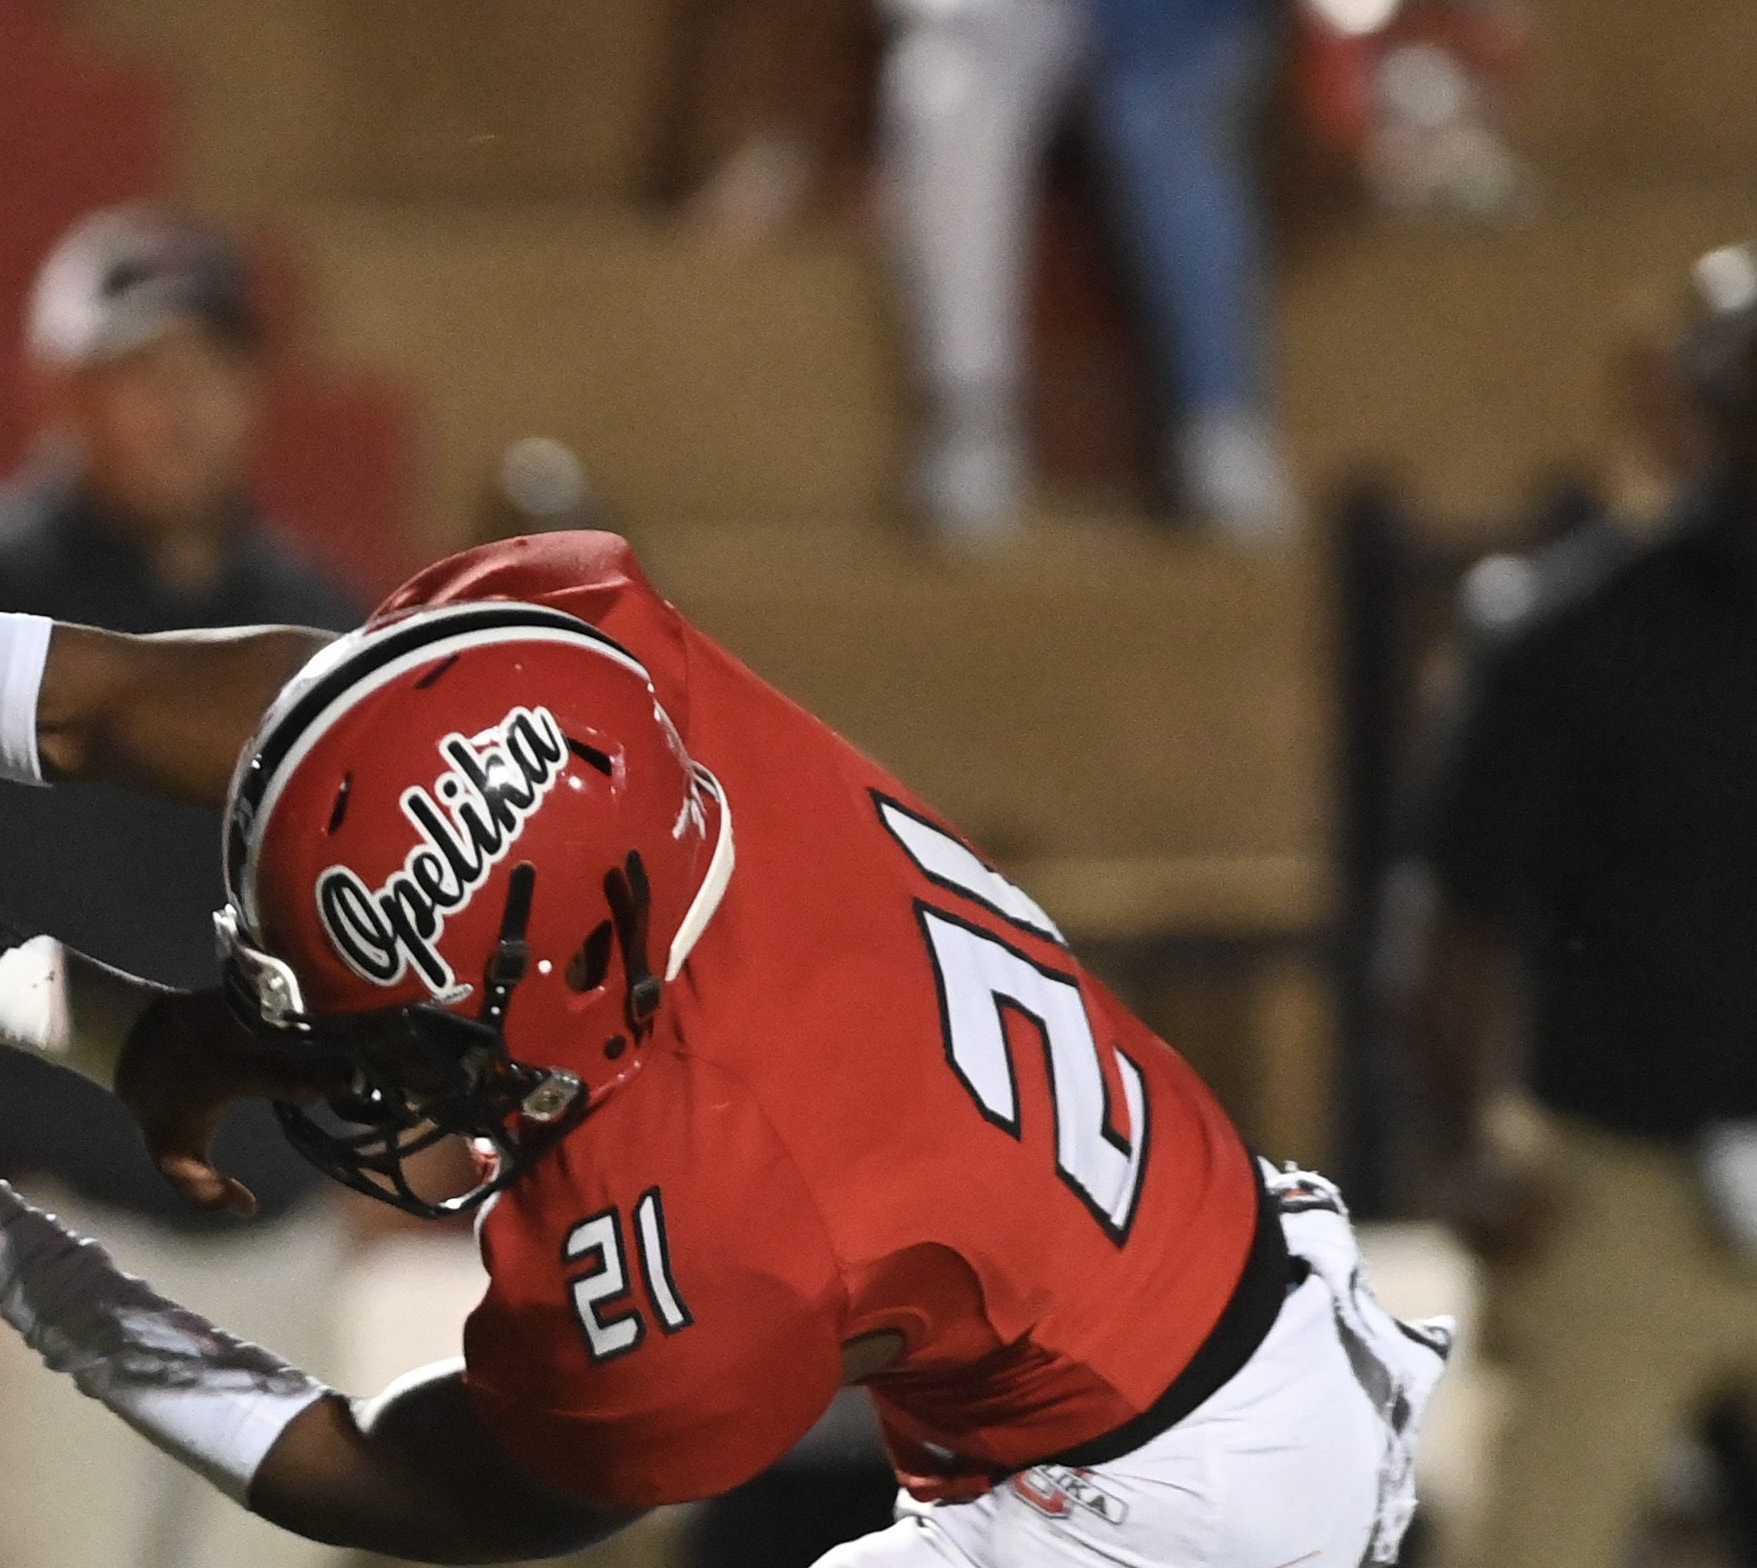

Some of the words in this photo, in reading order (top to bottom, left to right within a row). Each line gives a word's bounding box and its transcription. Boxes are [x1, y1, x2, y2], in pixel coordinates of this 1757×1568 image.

[315, 706, 569, 988] Opelika
[867, 786, 1151, 1250] 21
[560, 1185, 695, 1366] 21
